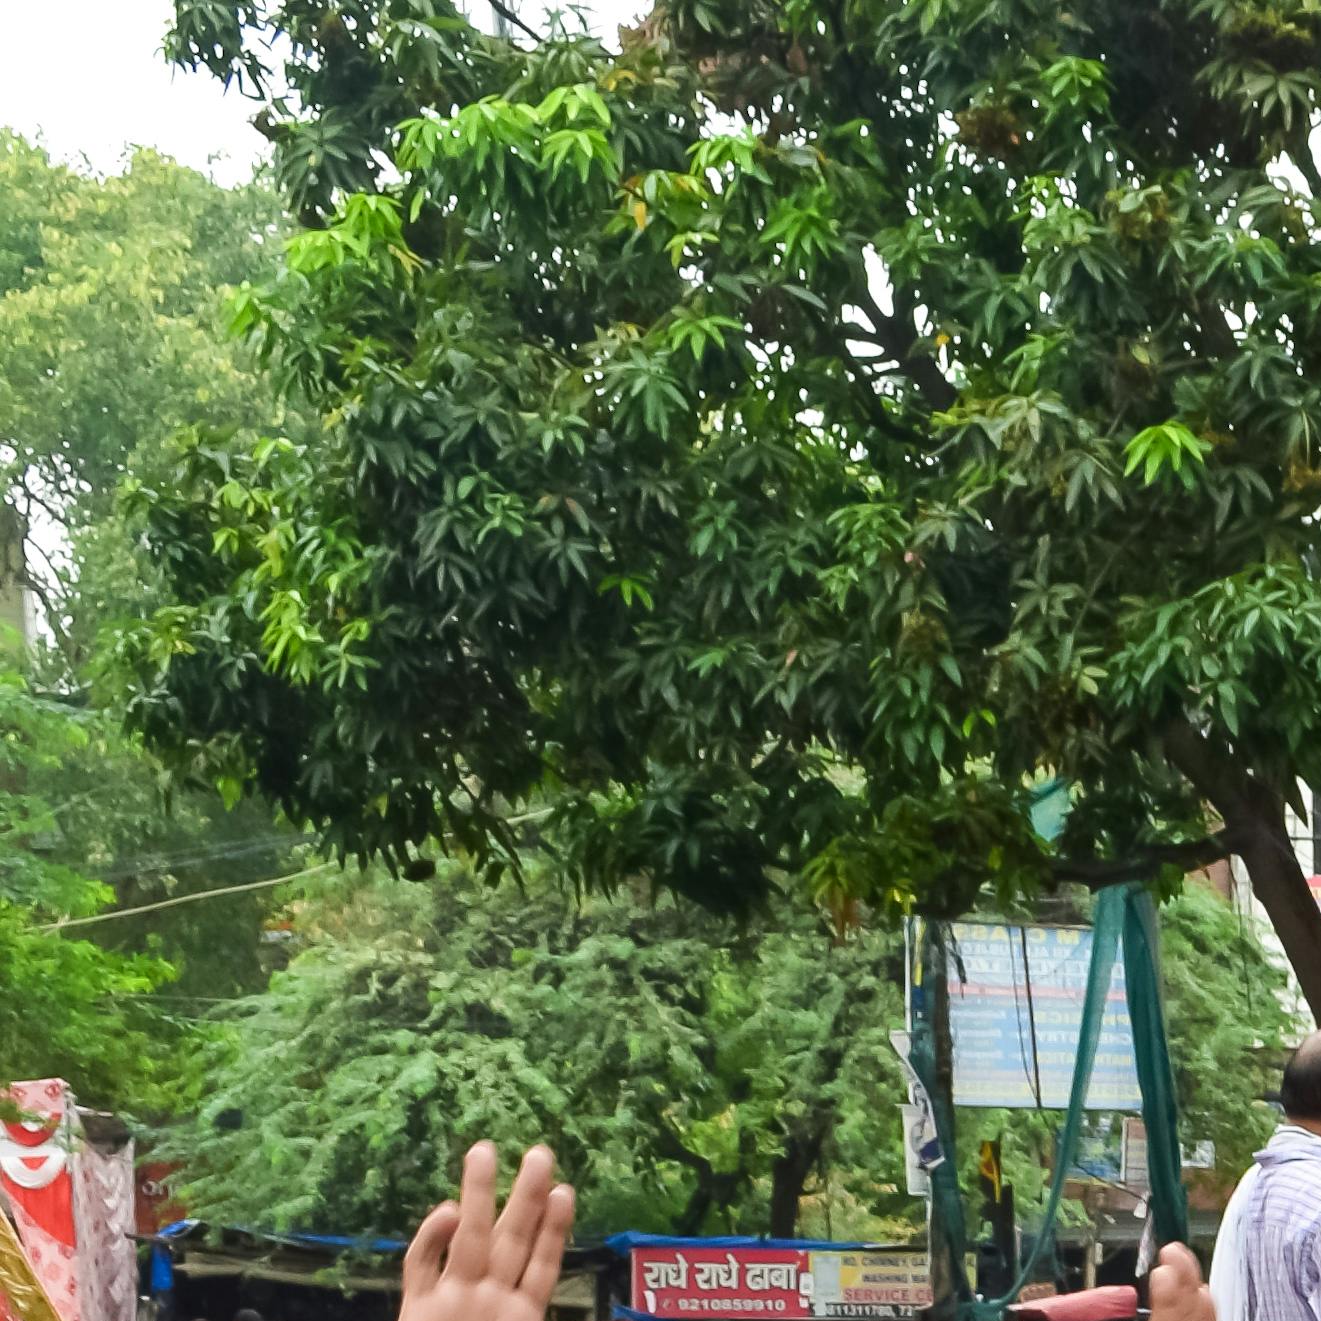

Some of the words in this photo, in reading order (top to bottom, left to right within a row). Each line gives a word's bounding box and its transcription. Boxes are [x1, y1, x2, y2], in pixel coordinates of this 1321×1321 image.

[643, 1252, 688, 1289] राधे
[694, 1253, 740, 1290] राधे
[745, 1262, 800, 1291] ढाबा
[844, 1288, 909, 1302] SERVICE
